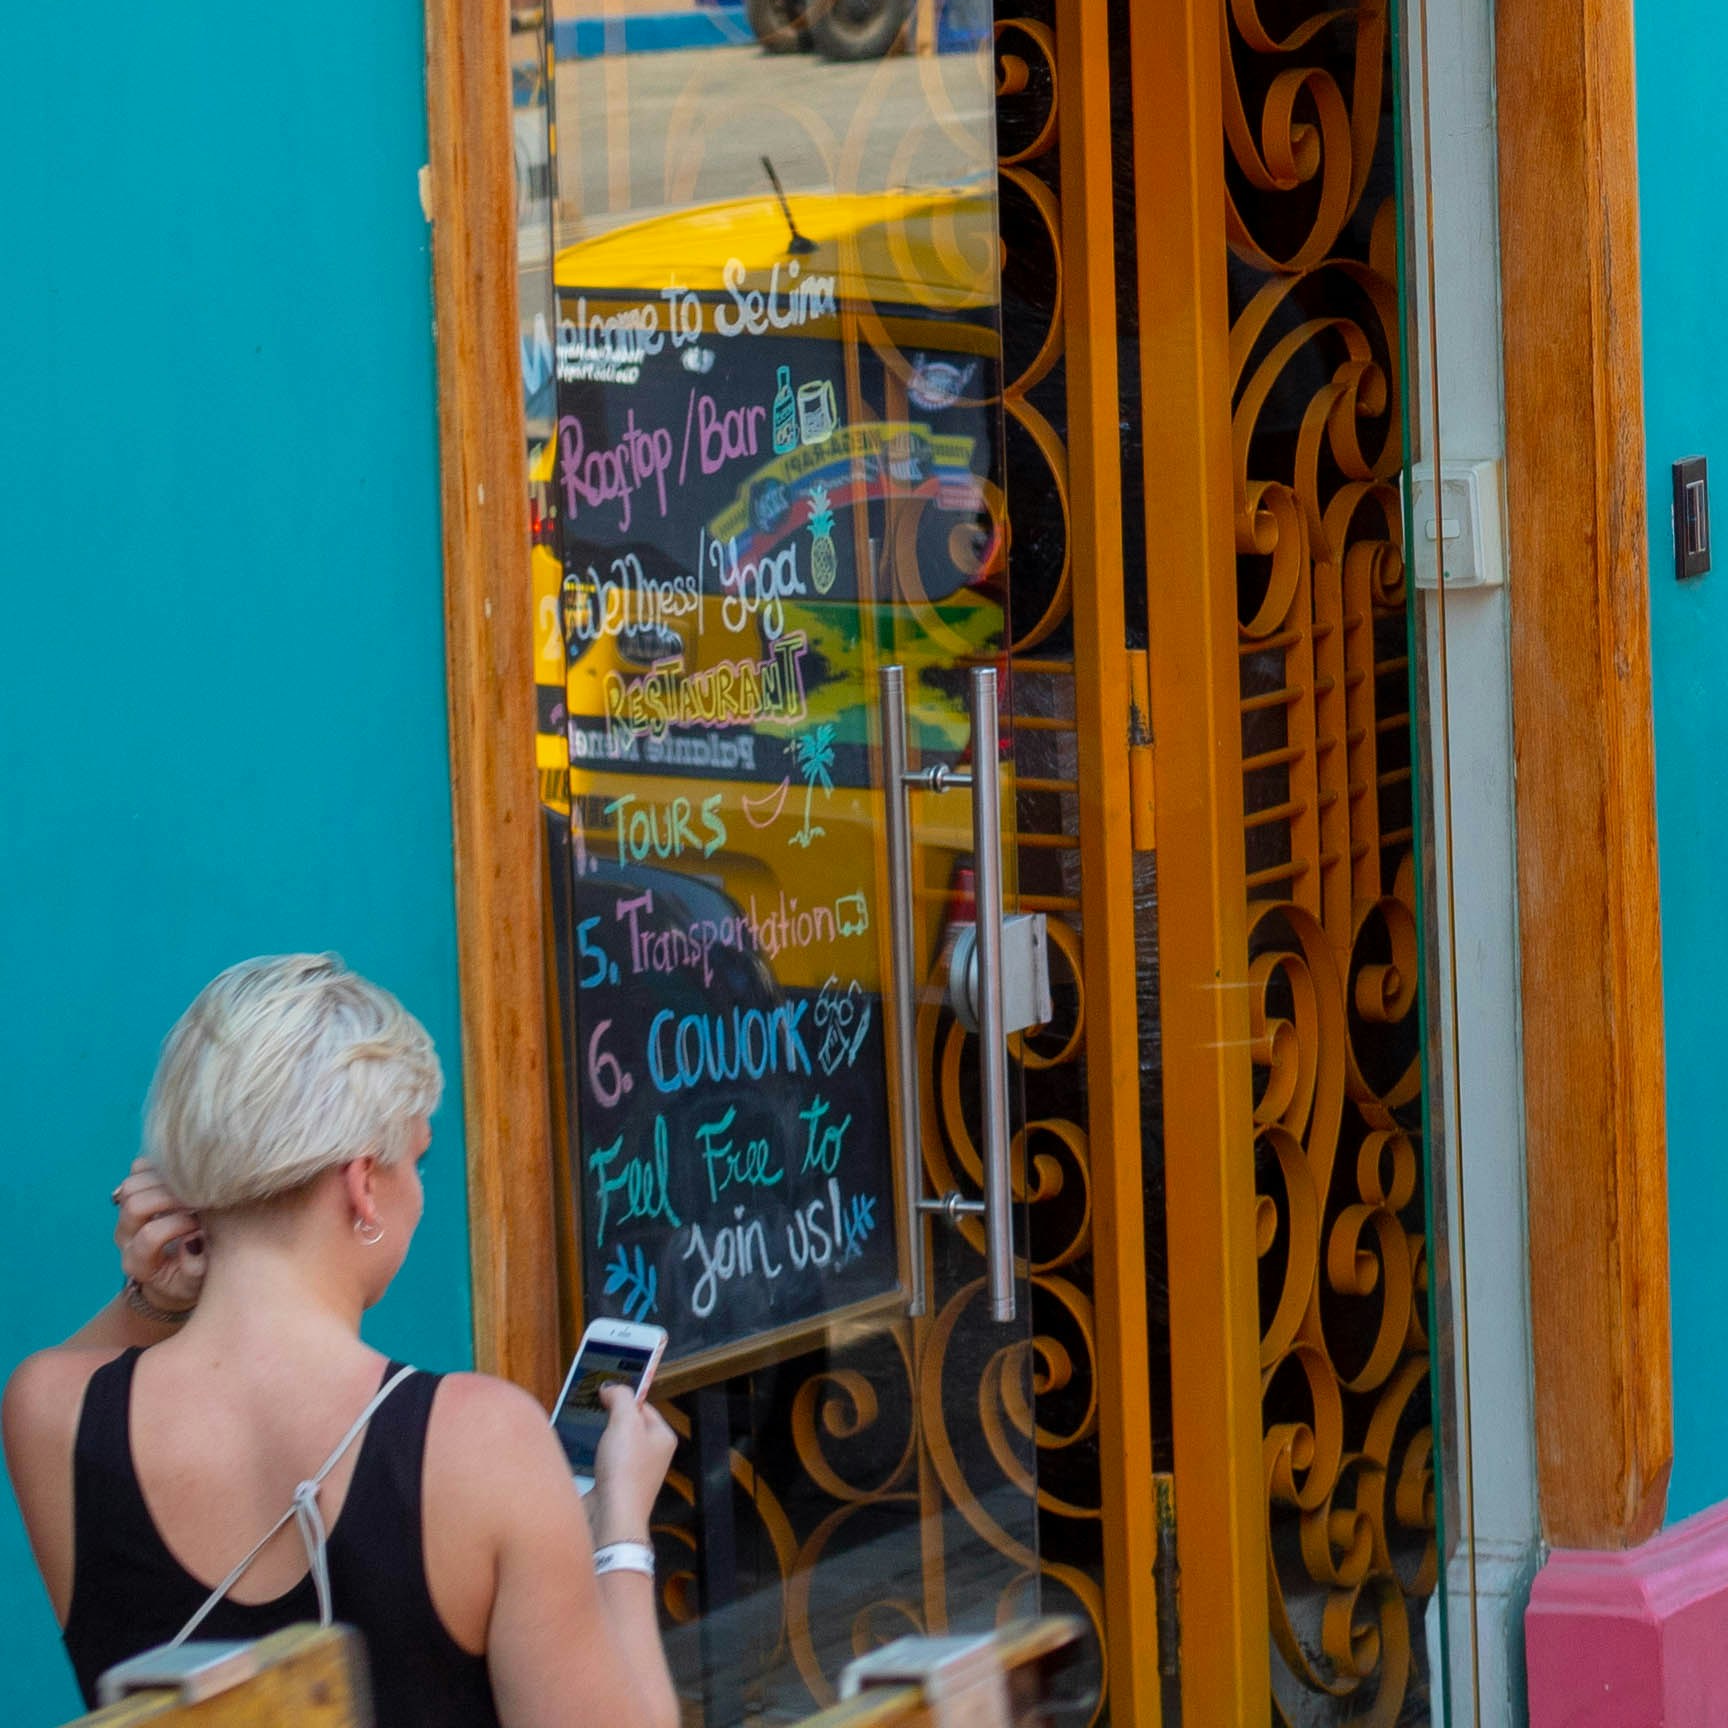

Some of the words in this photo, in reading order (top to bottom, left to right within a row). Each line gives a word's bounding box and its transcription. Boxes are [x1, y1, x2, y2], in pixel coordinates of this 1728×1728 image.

[575, 916, 620, 989] 5.
[616, 890, 835, 989] Transportation
[588, 1019, 633, 1108] 6.
[588, 1113, 682, 1249] Feel
[695, 1104, 784, 1204] Free
[799, 1094, 852, 1174] to
